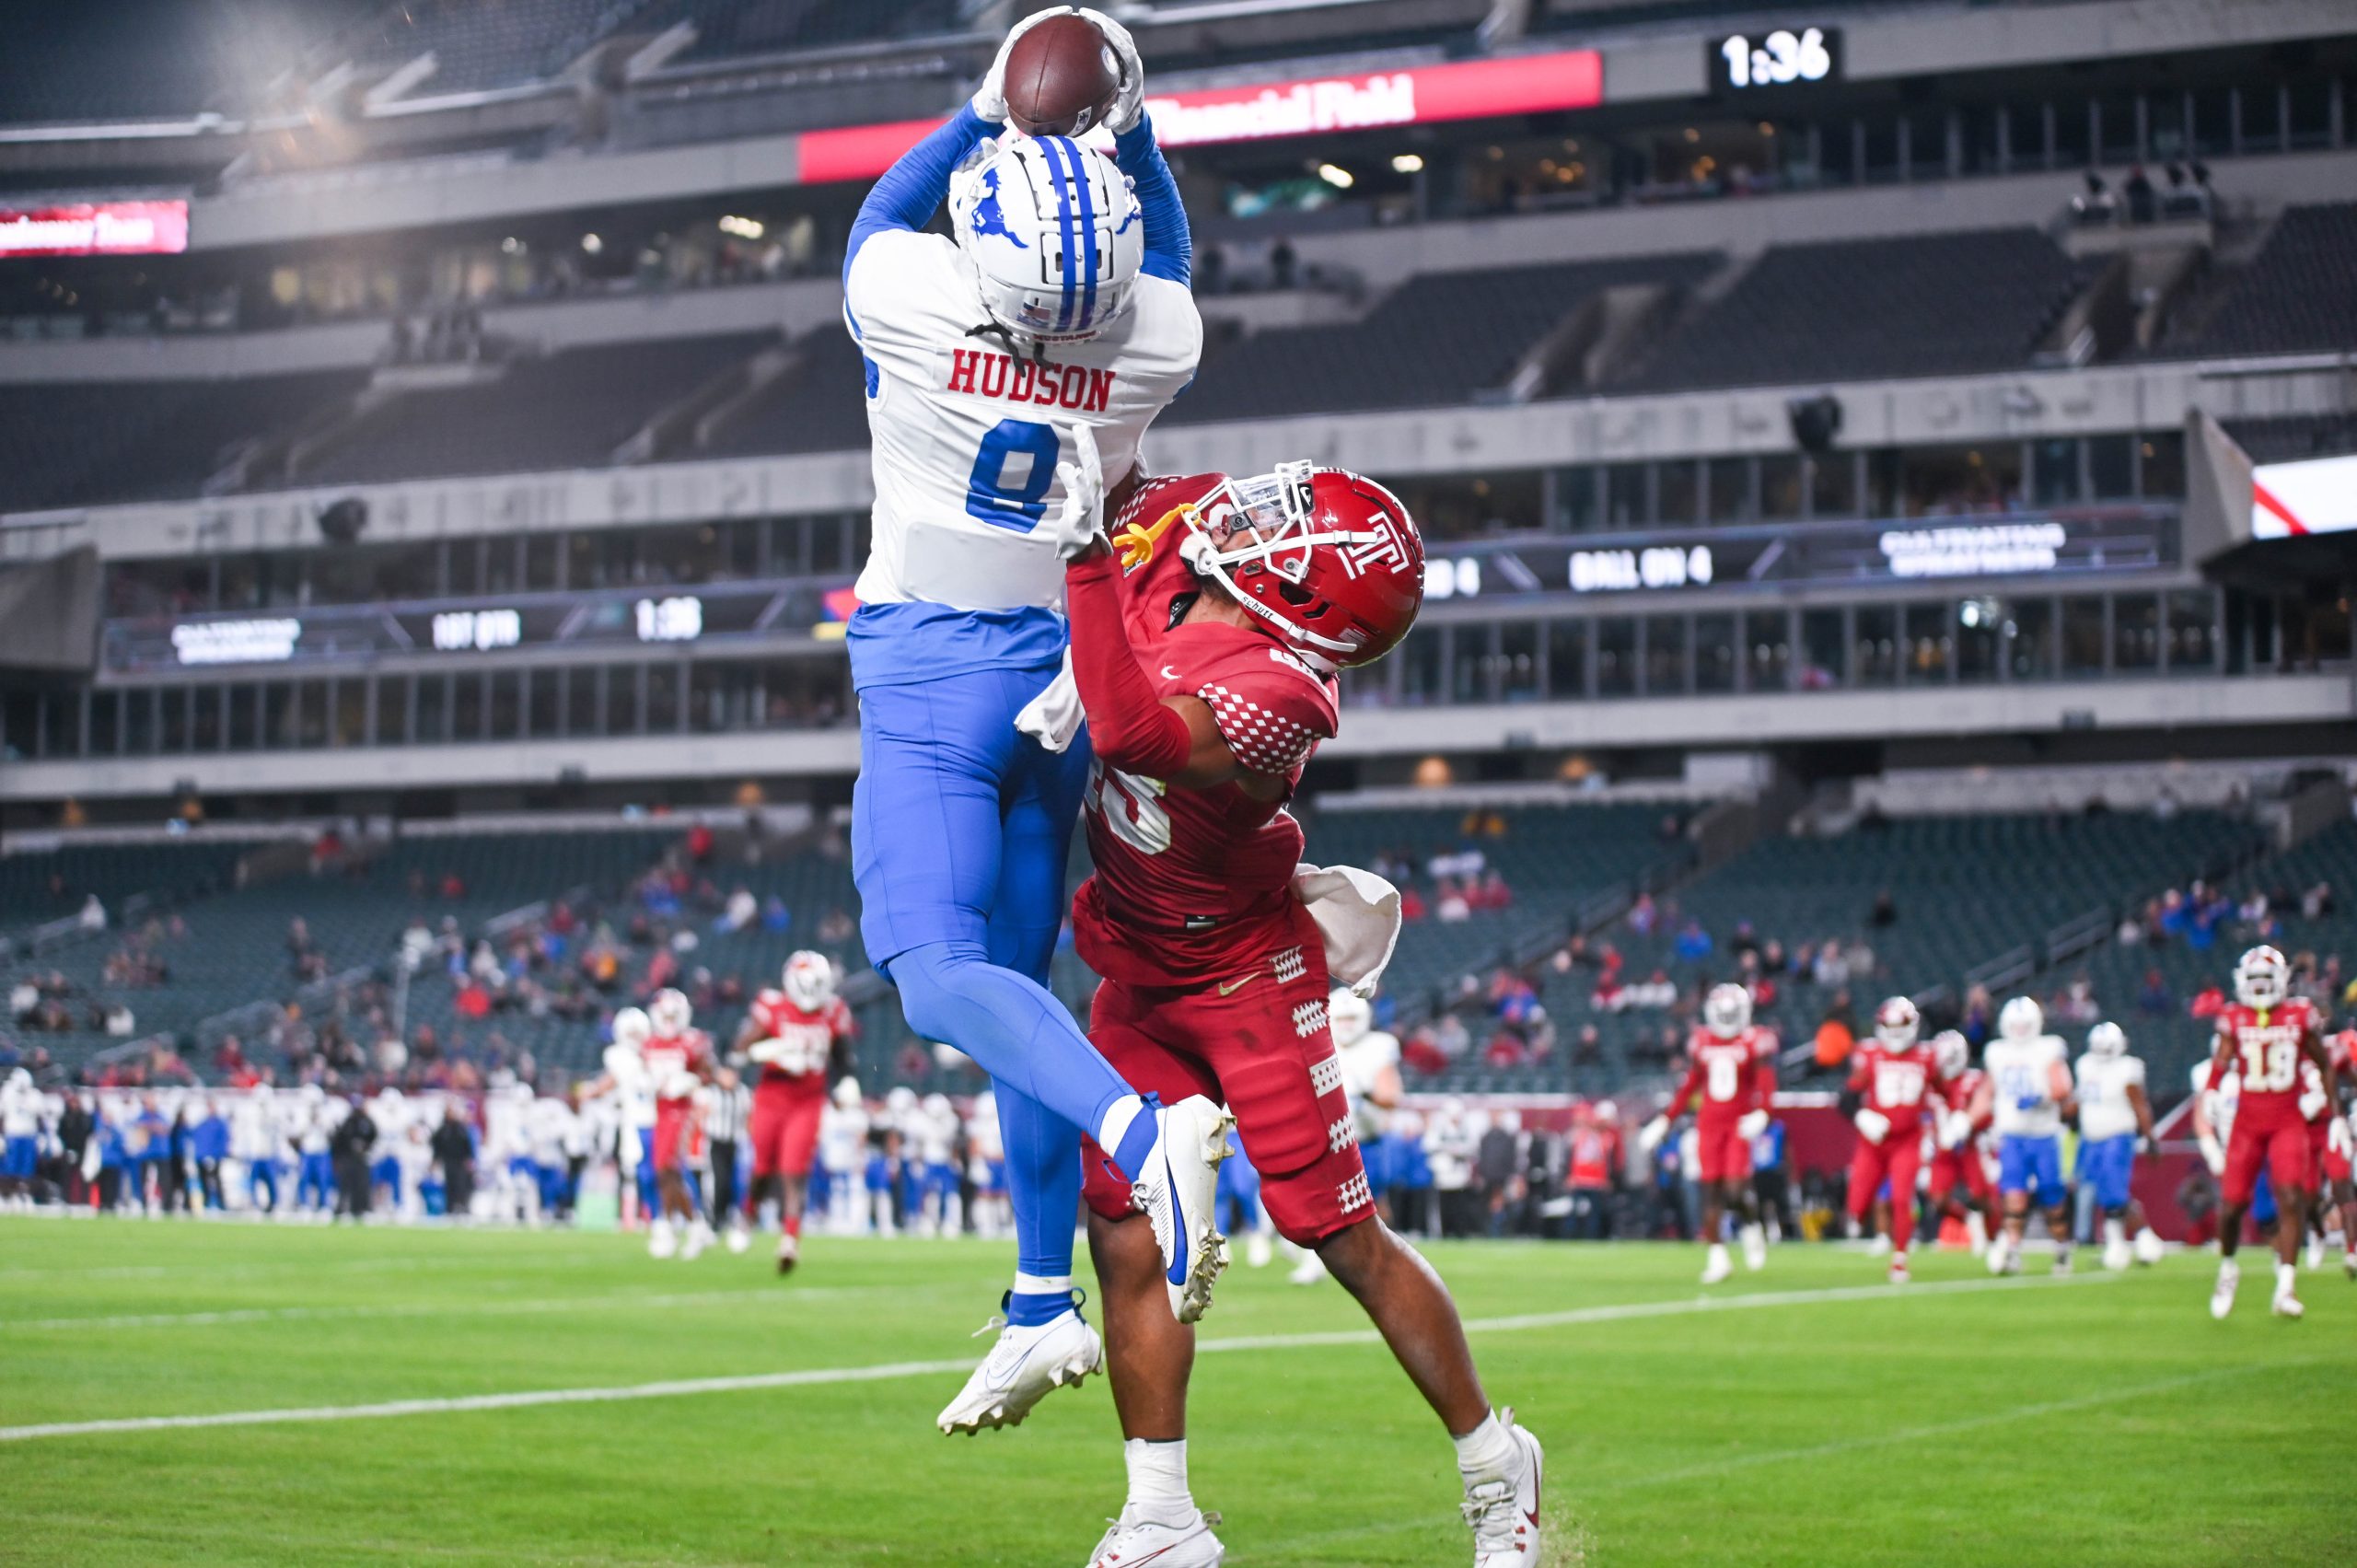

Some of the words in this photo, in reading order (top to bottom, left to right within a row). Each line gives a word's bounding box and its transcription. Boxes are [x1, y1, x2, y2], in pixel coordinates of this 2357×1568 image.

[1722, 28, 1830, 87] 1:36
[947, 348, 1116, 412] HUDSON
[1243, 596, 1273, 619] schutt
